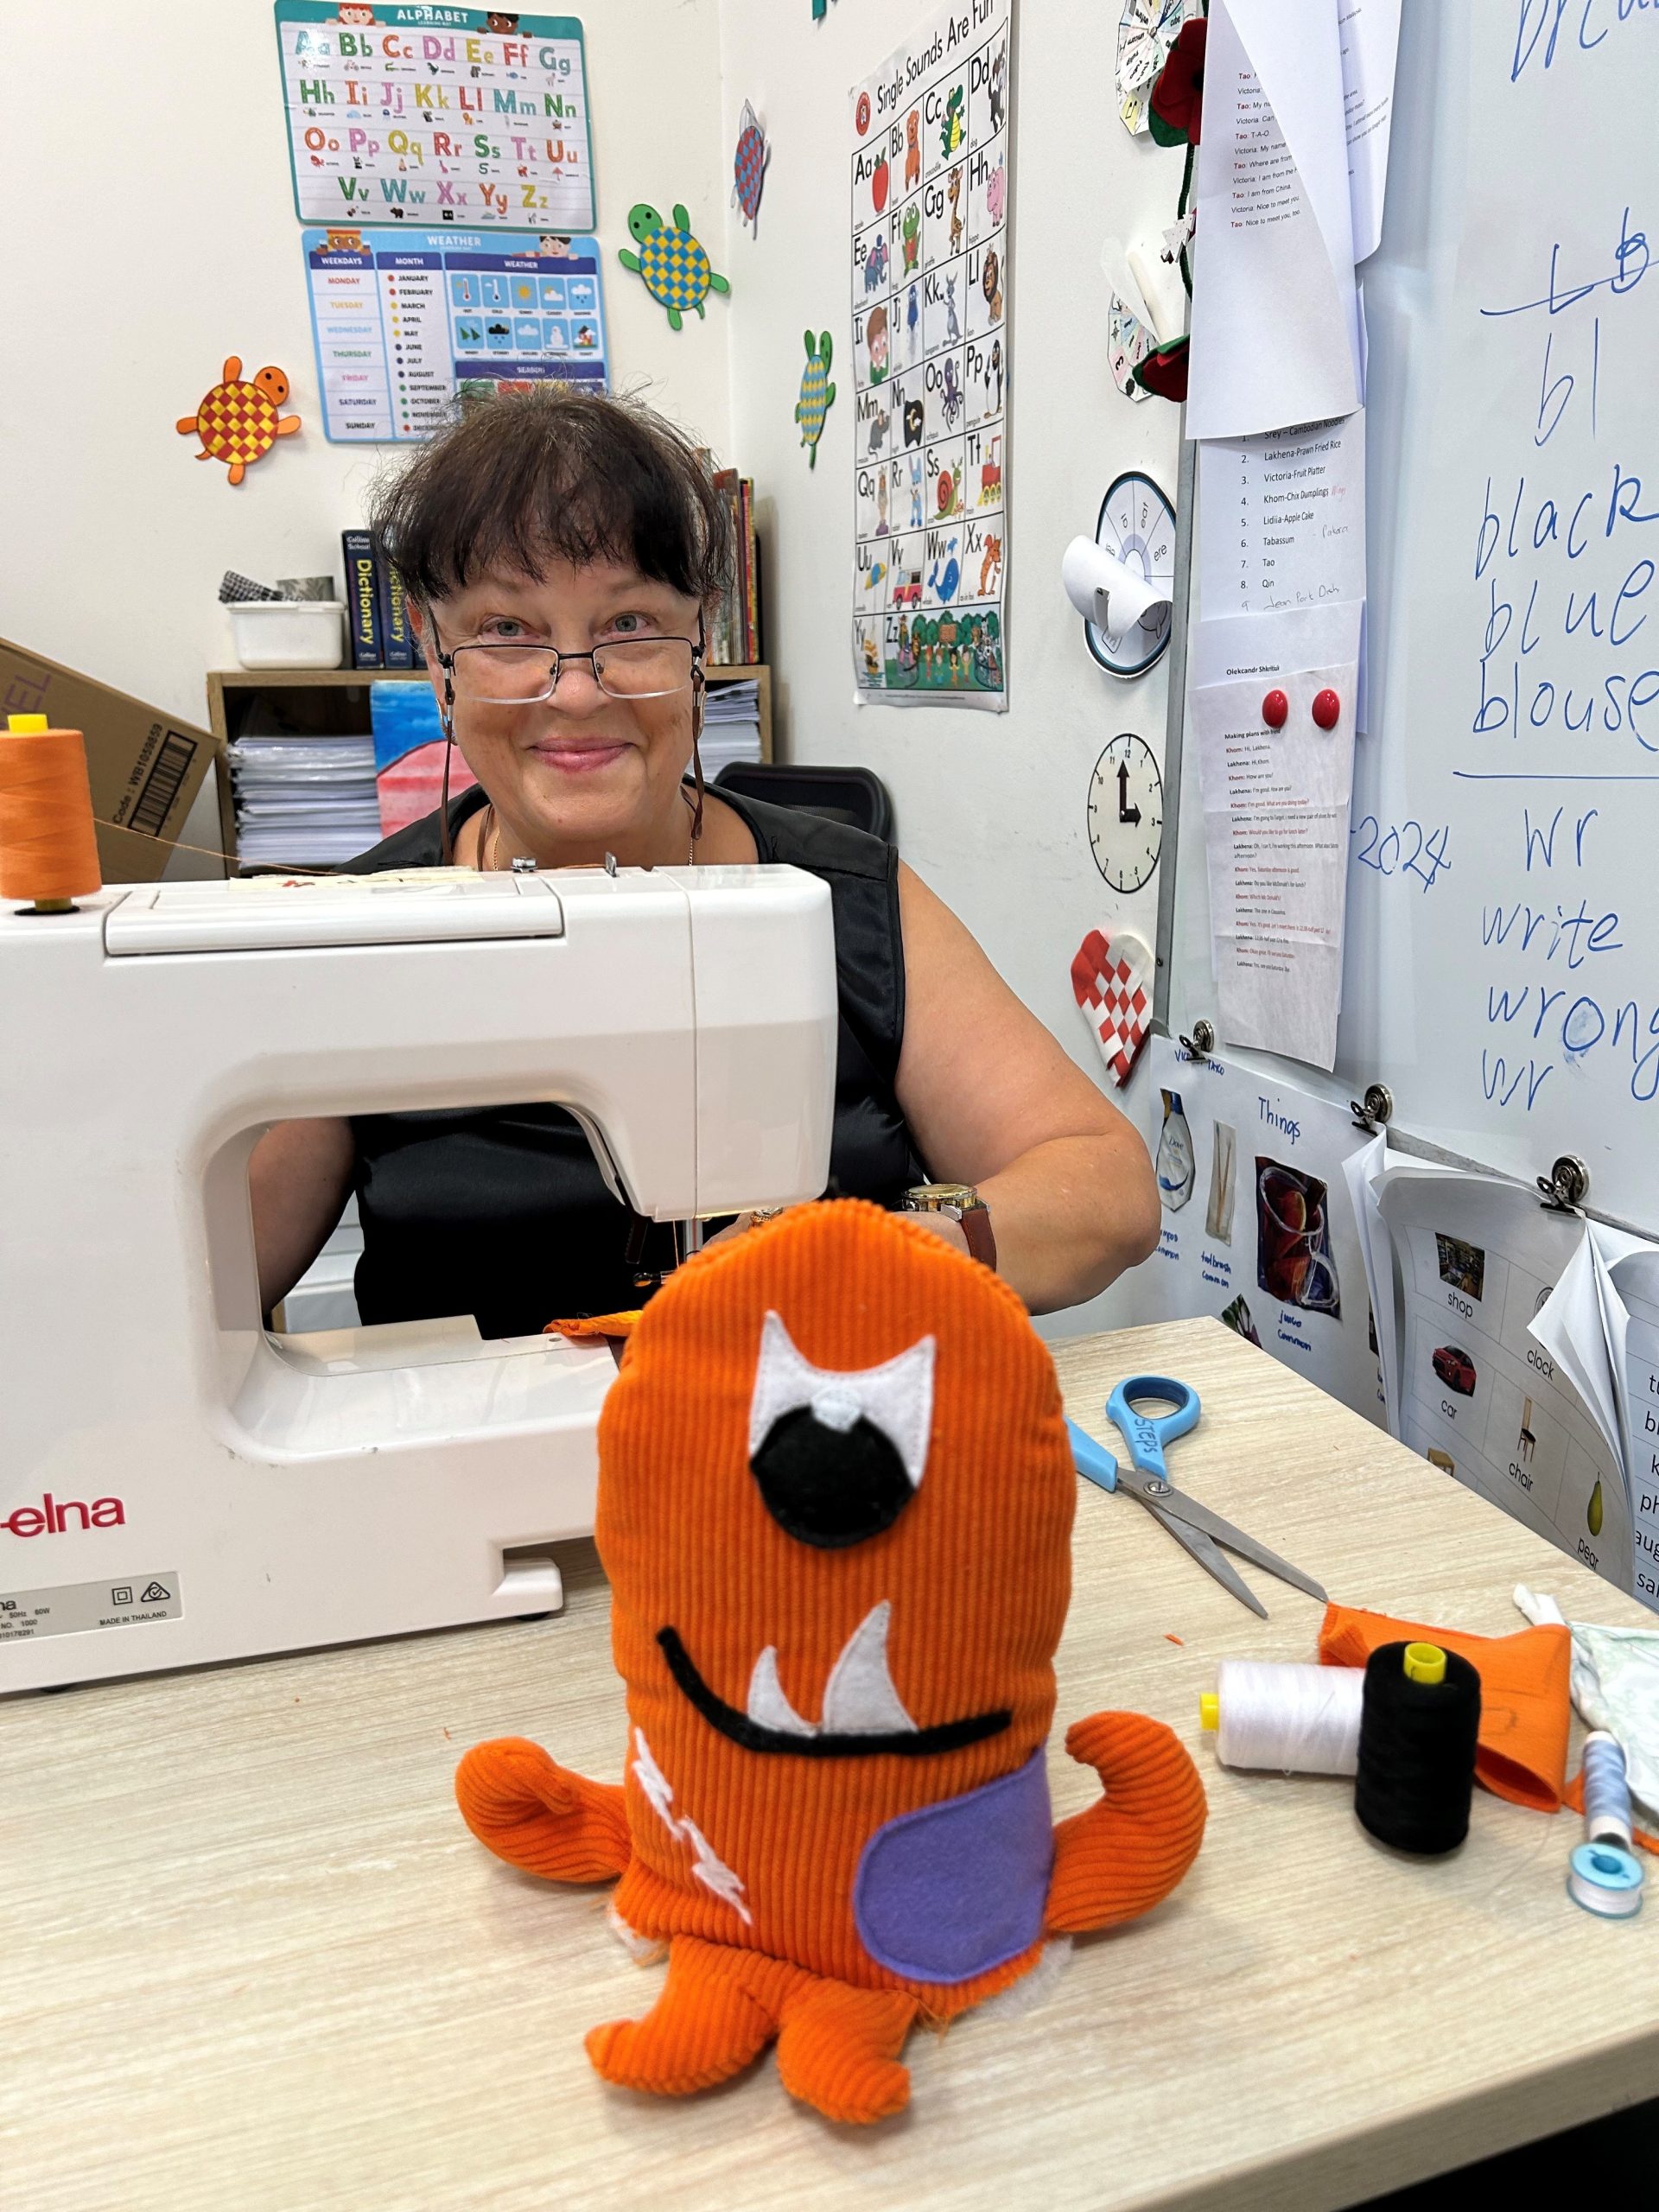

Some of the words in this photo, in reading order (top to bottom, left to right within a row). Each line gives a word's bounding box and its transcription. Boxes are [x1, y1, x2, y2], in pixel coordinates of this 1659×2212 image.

[397, 8, 468, 23] ALPHABET
[339, 32, 373, 57] Bb
[382, 35, 413, 59] Cc
[423, 35, 456, 61] Dd
[465, 38, 494, 65] Ee
[503, 42, 530, 67] Ff
[539, 46, 571, 75] Gg
[877, 68, 904, 114] Single
[906, 31, 943, 86] Sounds
[947, 16, 969, 53] Are
[972, 0, 994, 29] Fun
[300, 79, 335, 105] Hh
[345, 80, 368, 105] Ii
[380, 82, 403, 114] Jj
[415, 83, 450, 109] Kk
[459, 86, 483, 111] Ll
[493, 89, 537, 116] Mm
[544, 92, 576, 118] Nn
[855, 154, 873, 186] Aa
[891, 123, 904, 159] Bb
[925, 92, 942, 124] Cc
[971, 46, 989, 94] Dd
[304, 126, 340, 152] Oo
[348, 128, 380, 157] Pp
[388, 130, 424, 166] Qq
[433, 131, 462, 157] Rr
[474, 134, 501, 159] Ss
[511, 137, 537, 161] Tt
[546, 138, 578, 163] Uu
[338, 176, 370, 201] Vv
[380, 178, 426, 203] Ww
[436, 180, 467, 206] Xx
[479, 182, 508, 214] Yy
[520, 184, 549, 208] Zz
[1276, 198, 1290, 207] meet
[854, 237, 867, 266] Ee
[891, 209, 901, 245] Ff
[925, 184, 944, 219] Gg
[969, 150, 988, 191] Hh
[1267, 214, 1280, 223] meet
[427, 235, 481, 247] WEATHER
[321, 257, 363, 265] WEEKDAYS
[504, 260, 538, 269] WEATHER
[855, 316, 863, 345] Ii
[893, 297, 901, 334] Jj
[924, 272, 941, 308] Kk
[969, 249, 979, 286] Ll
[857, 392, 879, 423] Mm
[892, 378, 905, 410] Nn
[925, 362, 943, 392] Oo
[966, 345, 983, 384] Pp
[1535, 317, 1600, 447] bl
[1289, 419, 1323, 435] Cambodian
[1241, 454, 1249, 464] 2.
[1264, 446, 1314, 461] Lakhena-Prawn
[1314, 442, 1329, 453] Fried
[1330, 439, 1342, 449] Rice
[857, 471, 875, 502] Qq
[892, 461, 904, 489] Rr
[926, 448, 940, 478] Ss
[967, 433, 981, 467] Tt
[1241, 476, 1249, 485] 3.
[1264, 468, 1307, 482] Victoria-Fruit
[1307, 465, 1325, 476] Platter
[1241, 498, 1249, 506] 4.
[1263, 491, 1300, 504] Khom-Chix
[1300, 486, 1329, 500] Dumplings
[1241, 518, 1249, 528] 5.
[1301, 512, 1314, 520] Cake
[1475, 463, 1659, 581] black
[857, 545, 873, 572] Uu
[891, 538, 904, 567] Vv
[927, 531, 947, 561] Ww
[965, 523, 982, 555] Xx
[1154, 544, 1167, 562] ere
[1241, 539, 1249, 549] 6.
[1263, 536, 1295, 547] Tabassum
[1241, 560, 1249, 569] 7.
[1263, 558, 1275, 567] Tao
[1240, 581, 1249, 589] 8.
[1262, 579, 1274, 590] Qin
[356, 559, 374, 645] Dictionary
[1480, 559, 1656, 663] blue
[854, 619, 867, 652] Yy
[886, 617, 899, 644] Zz
[1226, 666, 1258, 676] Olekcandr
[1472, 661, 1659, 752] blouse
[1109, 756, 1116, 765] 11
[1124, 749, 1131, 759] 12
[1140, 760, 1143, 768] 1
[1148, 784, 1154, 793] 2
[112, 795, 132, 824] Code
[1093, 804, 1098, 814] 9
[1150, 817, 1156, 827] 3
[1146, 847, 1151, 855] 4
[1105, 857, 1109, 867] 7
[1134, 866, 1139, 875] 5
[1119, 869, 1123, 879] 6
[1483, 899, 1624, 969] write
[1489, 986, 1659, 1101] wrong
[1258, 1096, 1300, 1145] Things
[1168, 1136, 1185, 1150] Dove
[1447, 1289, 1474, 1319] shop
[1526, 1348, 1555, 1381] clock
[1440, 1398, 1458, 1421] car
[1508, 1461, 1534, 1492] chair
[0, 1493, 126, 1537] elna
[1577, 1536, 1599, 1571] pear
[20, 1618, 38, 1627] 1000
[99, 1617, 122, 1626] MADE
[122, 1615, 130, 1624] IN
[131, 1611, 168, 1622] THAILAND
